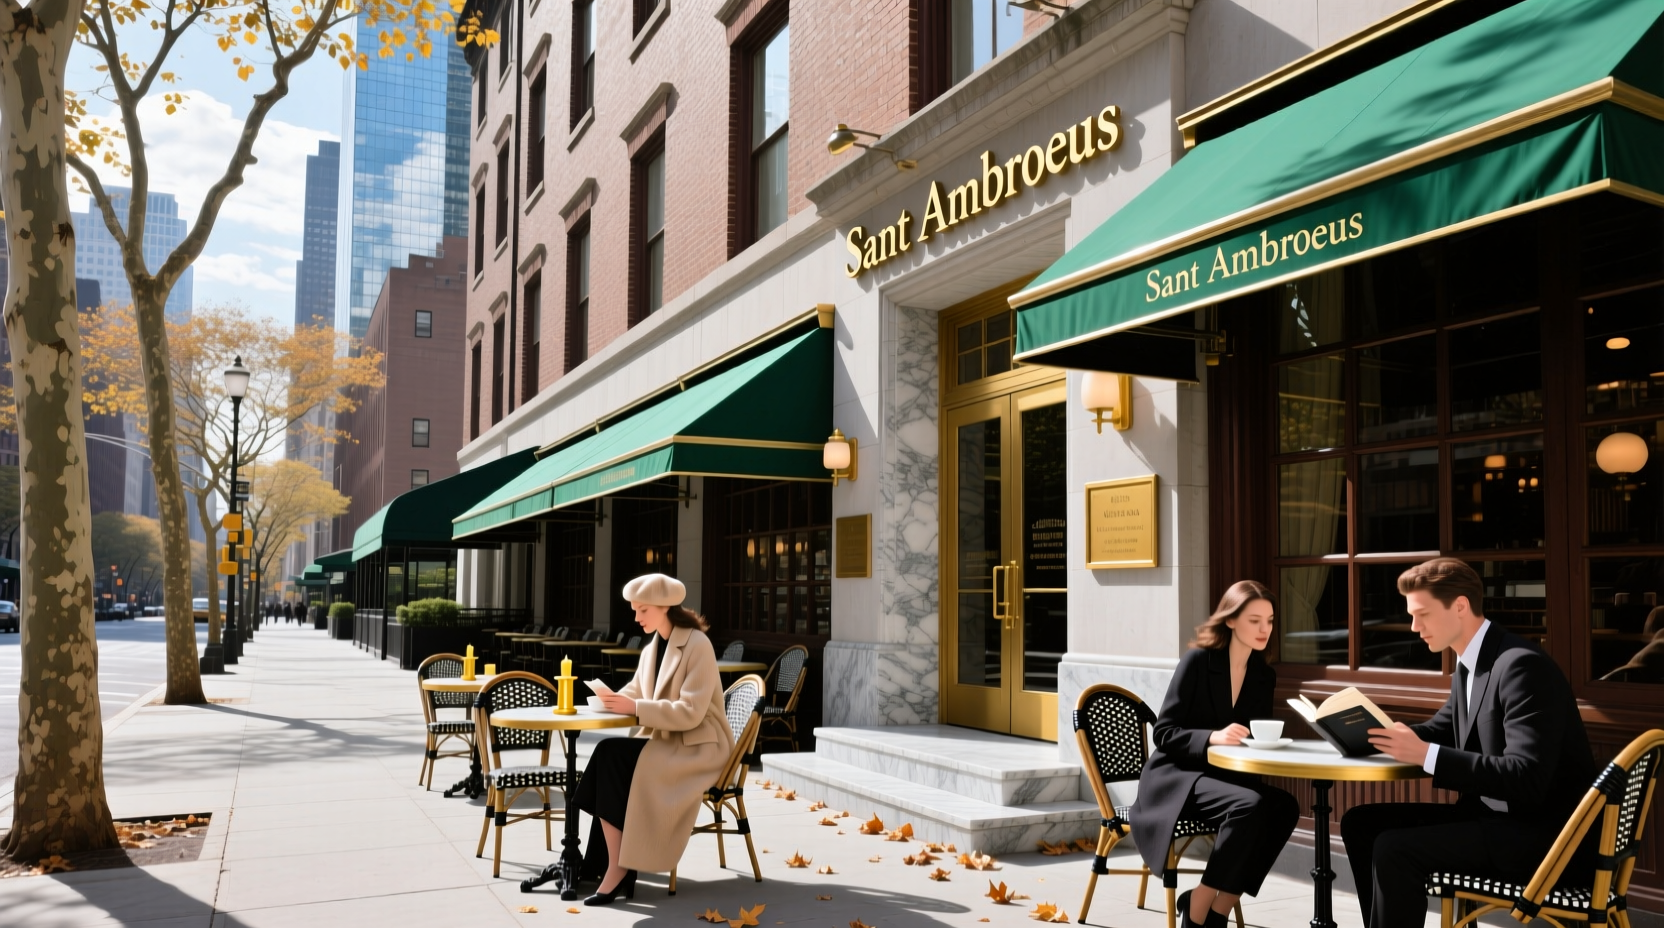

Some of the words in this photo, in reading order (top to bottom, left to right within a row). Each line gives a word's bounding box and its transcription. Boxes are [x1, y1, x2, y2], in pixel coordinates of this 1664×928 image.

[845, 209, 914, 279] Sant
[917, 105, 1123, 242] Ambroeus
[1145, 260, 1201, 304] Sant
[1207, 212, 1364, 284] Ambroeus
